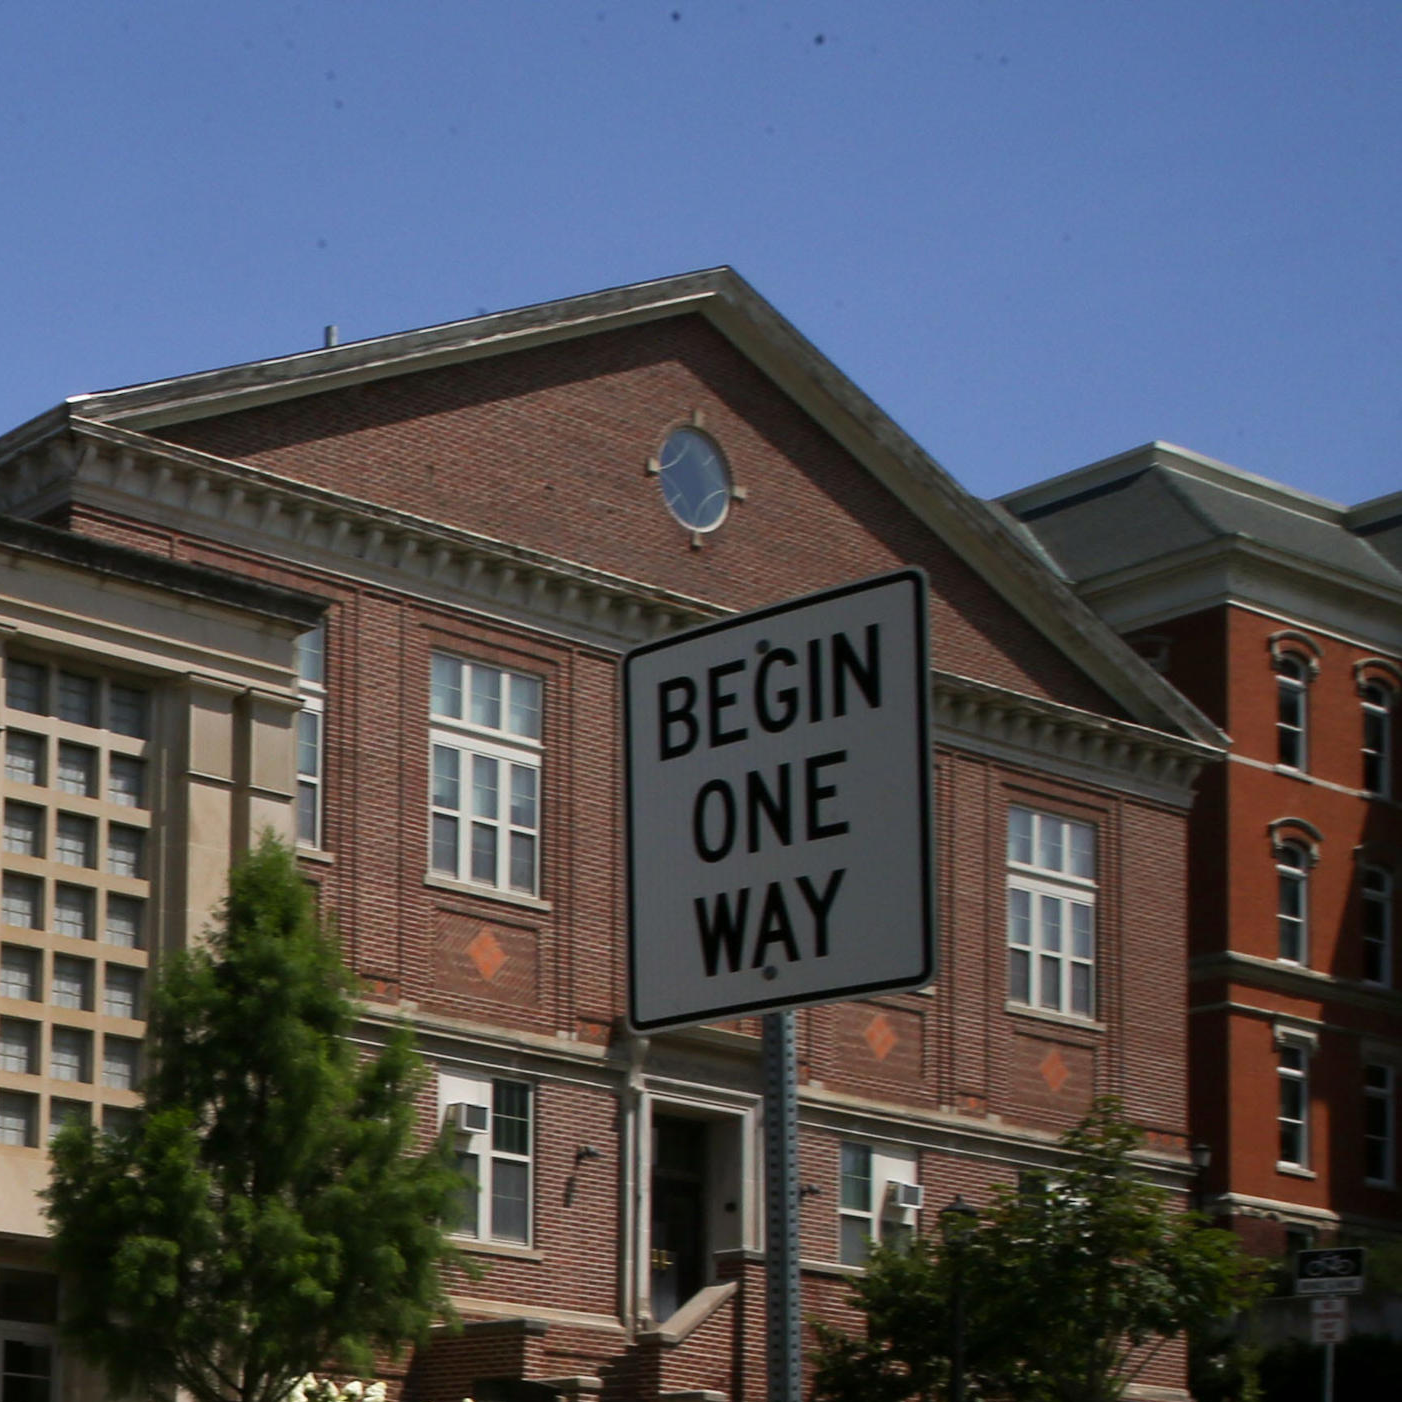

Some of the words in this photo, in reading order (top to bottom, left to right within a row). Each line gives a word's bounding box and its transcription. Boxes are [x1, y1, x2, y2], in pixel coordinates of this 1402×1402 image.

[657, 622, 882, 762] BEGIN
[693, 749, 851, 864] ONE
[693, 868, 847, 977] WAY
